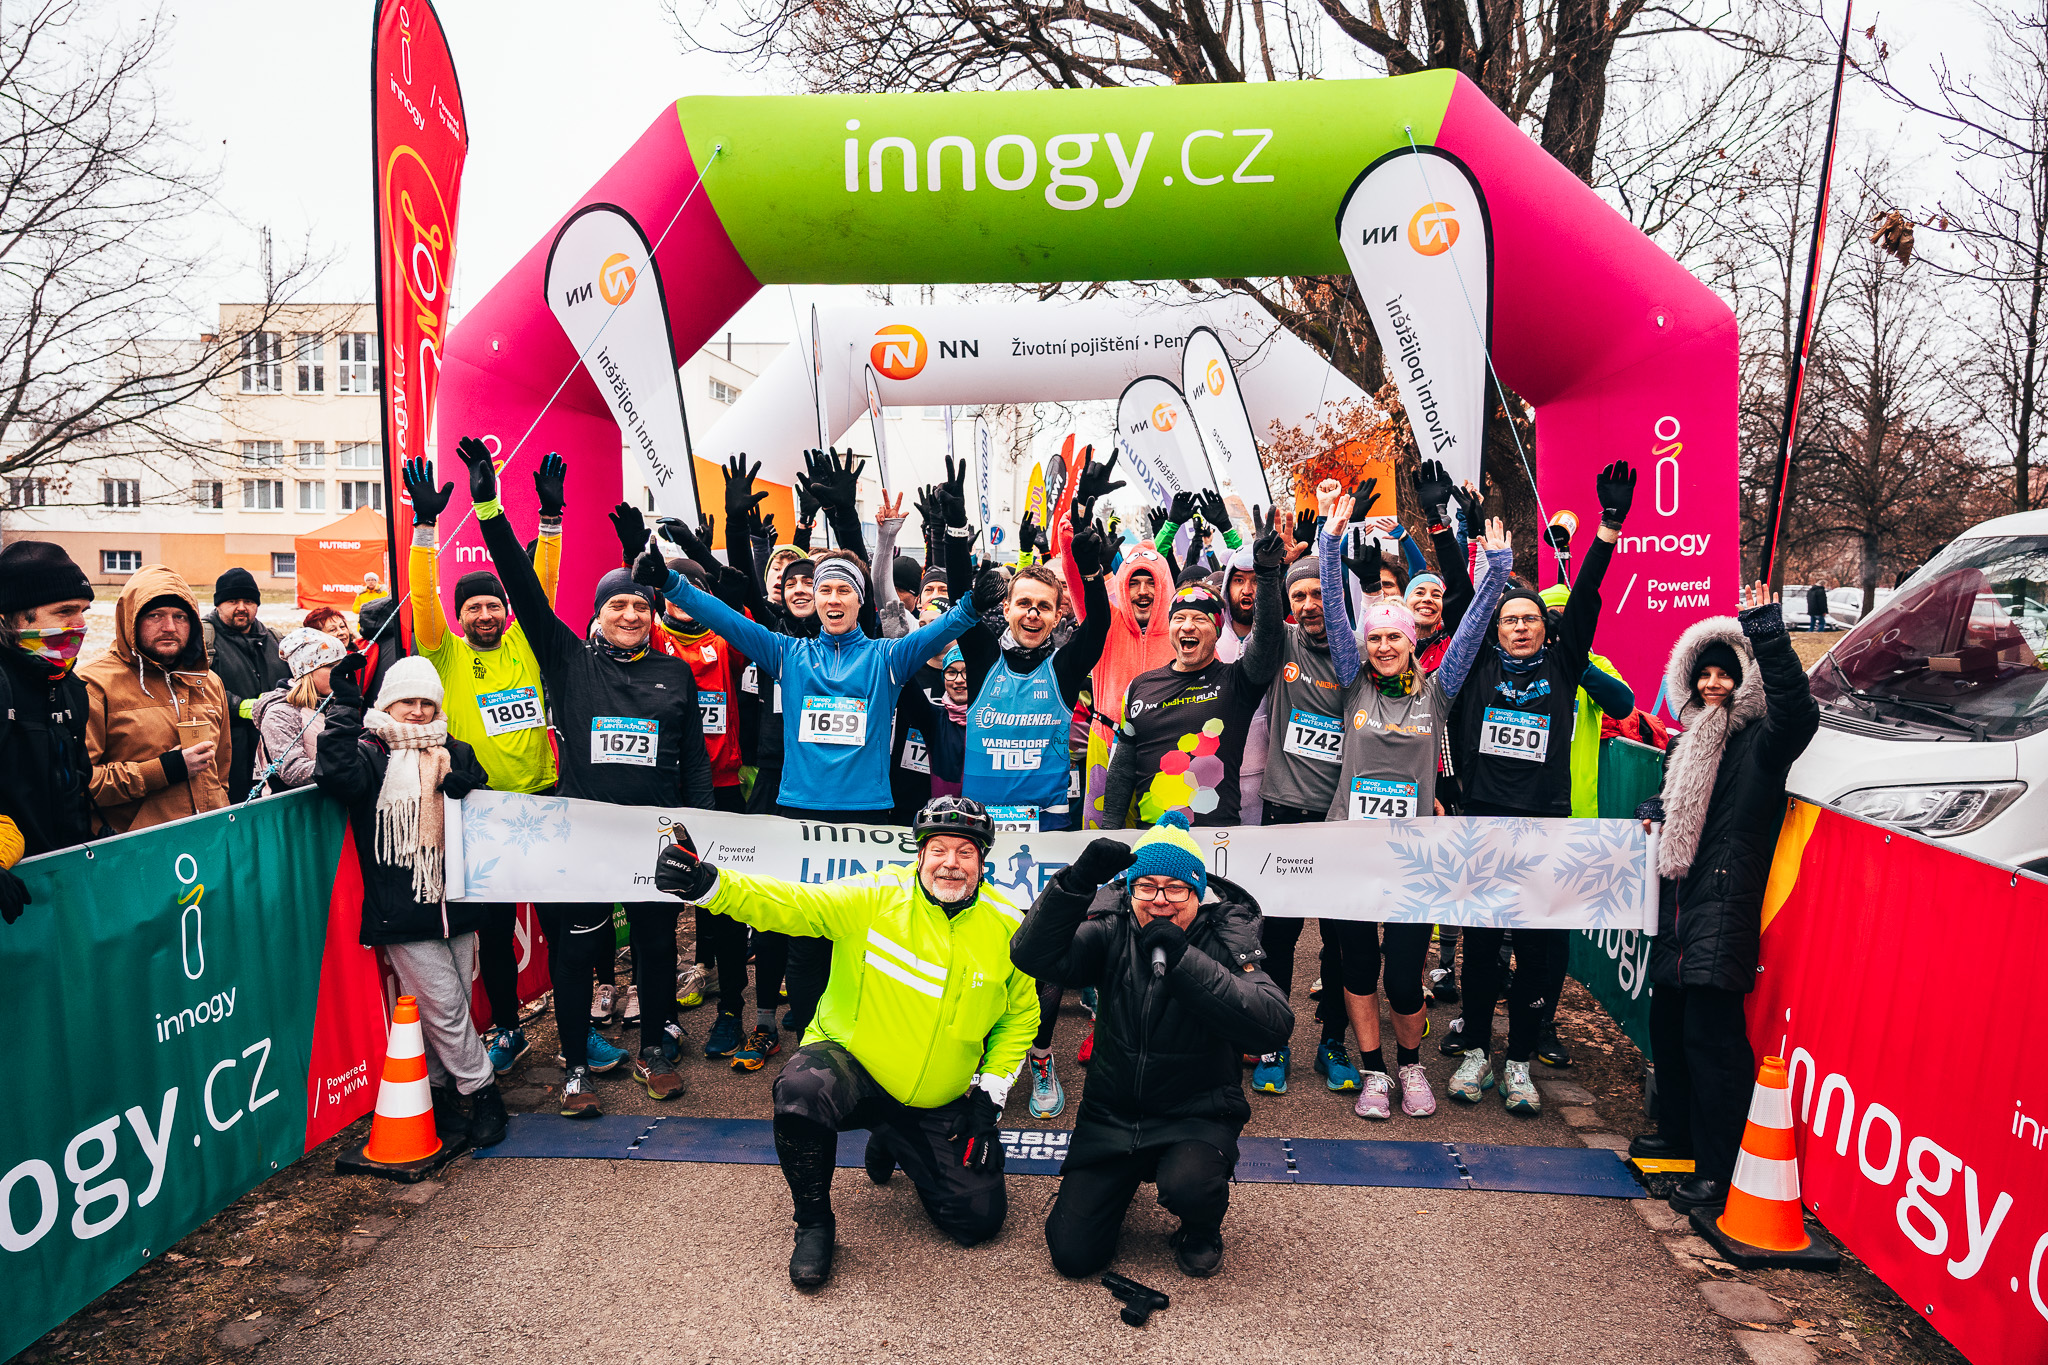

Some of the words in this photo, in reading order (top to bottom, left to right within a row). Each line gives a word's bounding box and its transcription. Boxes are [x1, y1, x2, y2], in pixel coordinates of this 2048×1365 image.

[391, 72, 425, 130] innogy
[844, 119, 1275, 210] innogy.cz
[938, 339, 979, 359] NN
[1011, 337, 1066, 357] Životní
[1071, 335, 1139, 357] pojištění
[319, 541, 361, 550] NUTREND
[456, 541, 494, 563] inn
[1617, 531, 1711, 557] innogy
[322, 584, 363, 593] NUTREND
[1647, 576, 1711, 592] Powered
[1647, 596, 1667, 612] by
[1673, 594, 1710, 609] MVM
[1300, 673, 1312, 684] NN
[487, 701, 537, 724] 1805
[700, 707, 718, 723] 75
[808, 712, 859, 733] 1659
[983, 709, 1062, 727] CYKLOTRENER.com
[1367, 719, 1382, 729] NN
[600, 733, 650, 754] 1673
[982, 738, 1050, 748] VARNSDORF
[1295, 727, 1341, 752] 1742
[1489, 725, 1541, 749] 1650
[911, 744, 929, 762] 17
[986, 748, 1042, 770] TOS
[1358, 796, 1408, 818] 1743
[800, 821, 918, 853] innog
[718, 854, 728, 863] by
[719, 845, 756, 853] Powered
[666, 859, 688, 870] CRAFT
[1276, 866, 1287, 875] by
[1290, 866, 1313, 874] MVM
[633, 873, 656, 884] inn
[155, 986, 236, 1043] innogy
[326, 1059, 367, 1090] Powered
[328, 1092, 341, 1105] by
[344, 1075, 368, 1097] MVM
[0, 1037, 280, 1252] ogy.cz
